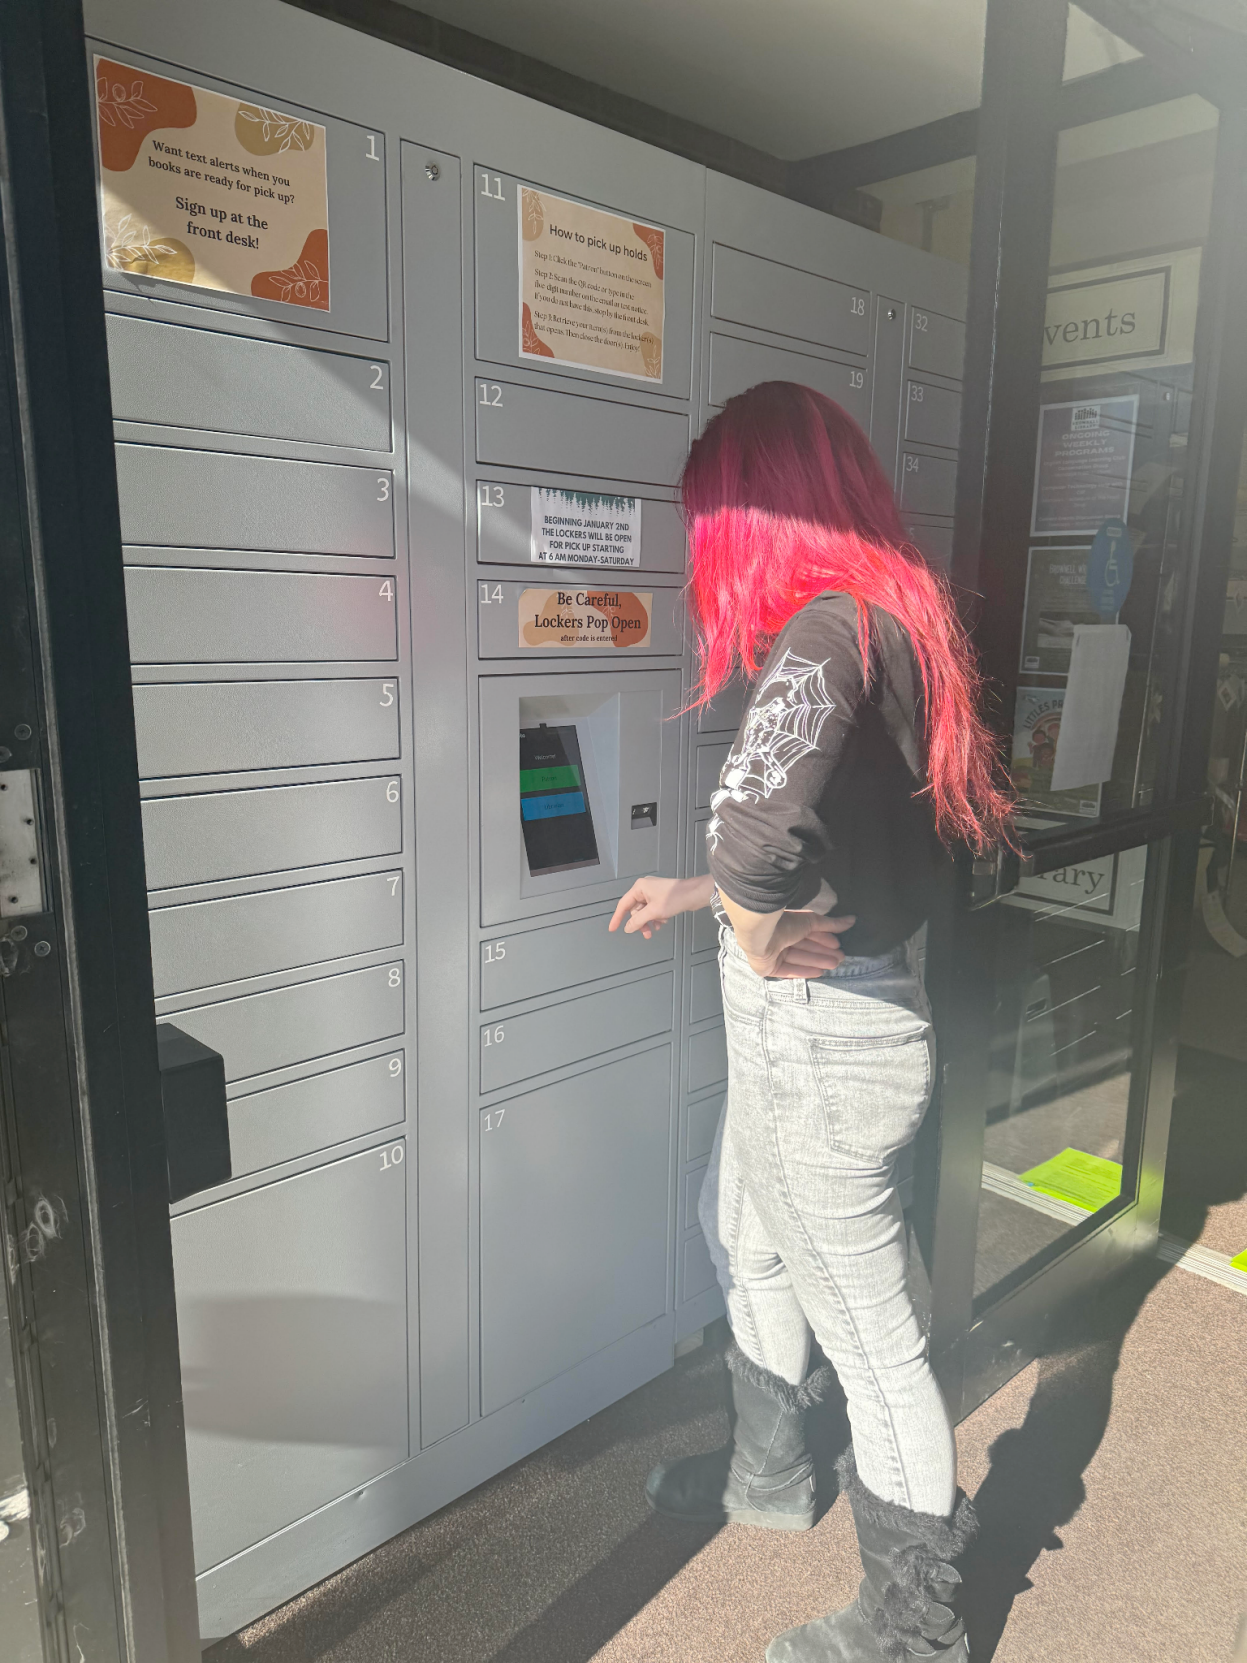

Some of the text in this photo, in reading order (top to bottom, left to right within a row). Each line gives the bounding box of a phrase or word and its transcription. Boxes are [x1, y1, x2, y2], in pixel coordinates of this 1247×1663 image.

[366, 135, 380, 161] 1
[152, 140, 290, 187] Want text alerts when you
[148, 156, 296, 204] books are ready for pick up?
[480, 173, 506, 201] 11
[176, 196, 268, 230] Sign up at the
[186, 221, 259, 250] front desk!
[550, 224, 648, 262] How to pick up holds
[535, 250, 548, 262] Step
[553, 255, 567, 265] Click
[568, 259, 577, 268] the
[600, 267, 617, 278] button
[626, 274, 634, 282] the
[535, 268, 634, 300] Step 2: Scan the QR code or type in the
[535, 280, 545, 289] five
[547, 283, 559, 294] digit
[560, 286, 581, 298] number
[590, 294, 598, 302] the
[631, 306, 648, 314] notice.
[850, 297, 864, 316] 18
[539, 294, 550, 302] you
[551, 296, 558, 304] do
[570, 300, 582, 310] have
[594, 308, 606, 318] stop
[607, 309, 613, 319] by
[614, 311, 622, 320] the
[623, 314, 635, 323] front
[534, 310, 547, 321] Step
[553, 315, 576, 326] Retrieve
[576, 321, 587, 329] your
[589, 324, 608, 334] item(s)
[609, 327, 622, 336] from
[622, 330, 630, 338] the
[534, 322, 545, 331] that
[565, 329, 579, 338] Then
[580, 332, 593, 342] close
[594, 335, 603, 343] the
[915, 313, 928, 332] 32
[1044, 308, 1136, 346] vents
[370, 364, 384, 390] 2
[849, 371, 863, 388] 19
[479, 383, 503, 407] 12
[911, 385, 924, 402] 33
[1062, 430, 1110, 440] ONGOING
[1063, 438, 1108, 448] WEEKLY
[1054, 446, 1115, 457] PROGRAMS
[906, 456, 919, 472] 34
[377, 477, 390, 502] 3
[481, 485, 505, 508] 13
[544, 515, 629, 531] BEGINNING JANUARY 2ND
[542, 528, 632, 543] THE LOCKERS WILL BE OPEN
[550, 540, 624, 553] FOR PICK UP STARTING
[538, 552, 547, 560] AT
[554, 553, 566, 562] AM
[568, 554, 634, 565] MONDAY-SATURDAY
[378, 580, 393, 602] 4
[480, 584, 504, 604] 14
[557, 592, 622, 609] Be Careful,
[535, 614, 641, 632] Lockers Pop Open
[560, 634, 575, 642] after
[379, 683, 394, 707] 5
[1022, 702, 1050, 729] LITTLES
[386, 781, 399, 803] 6
[387, 876, 400, 897] 7
[484, 941, 506, 964] 15
[388, 968, 400, 988] 8
[483, 1025, 505, 1047] 16
[388, 1058, 402, 1078] 9
[484, 1108, 506, 1132] 17
[379, 1144, 404, 1171] 10
